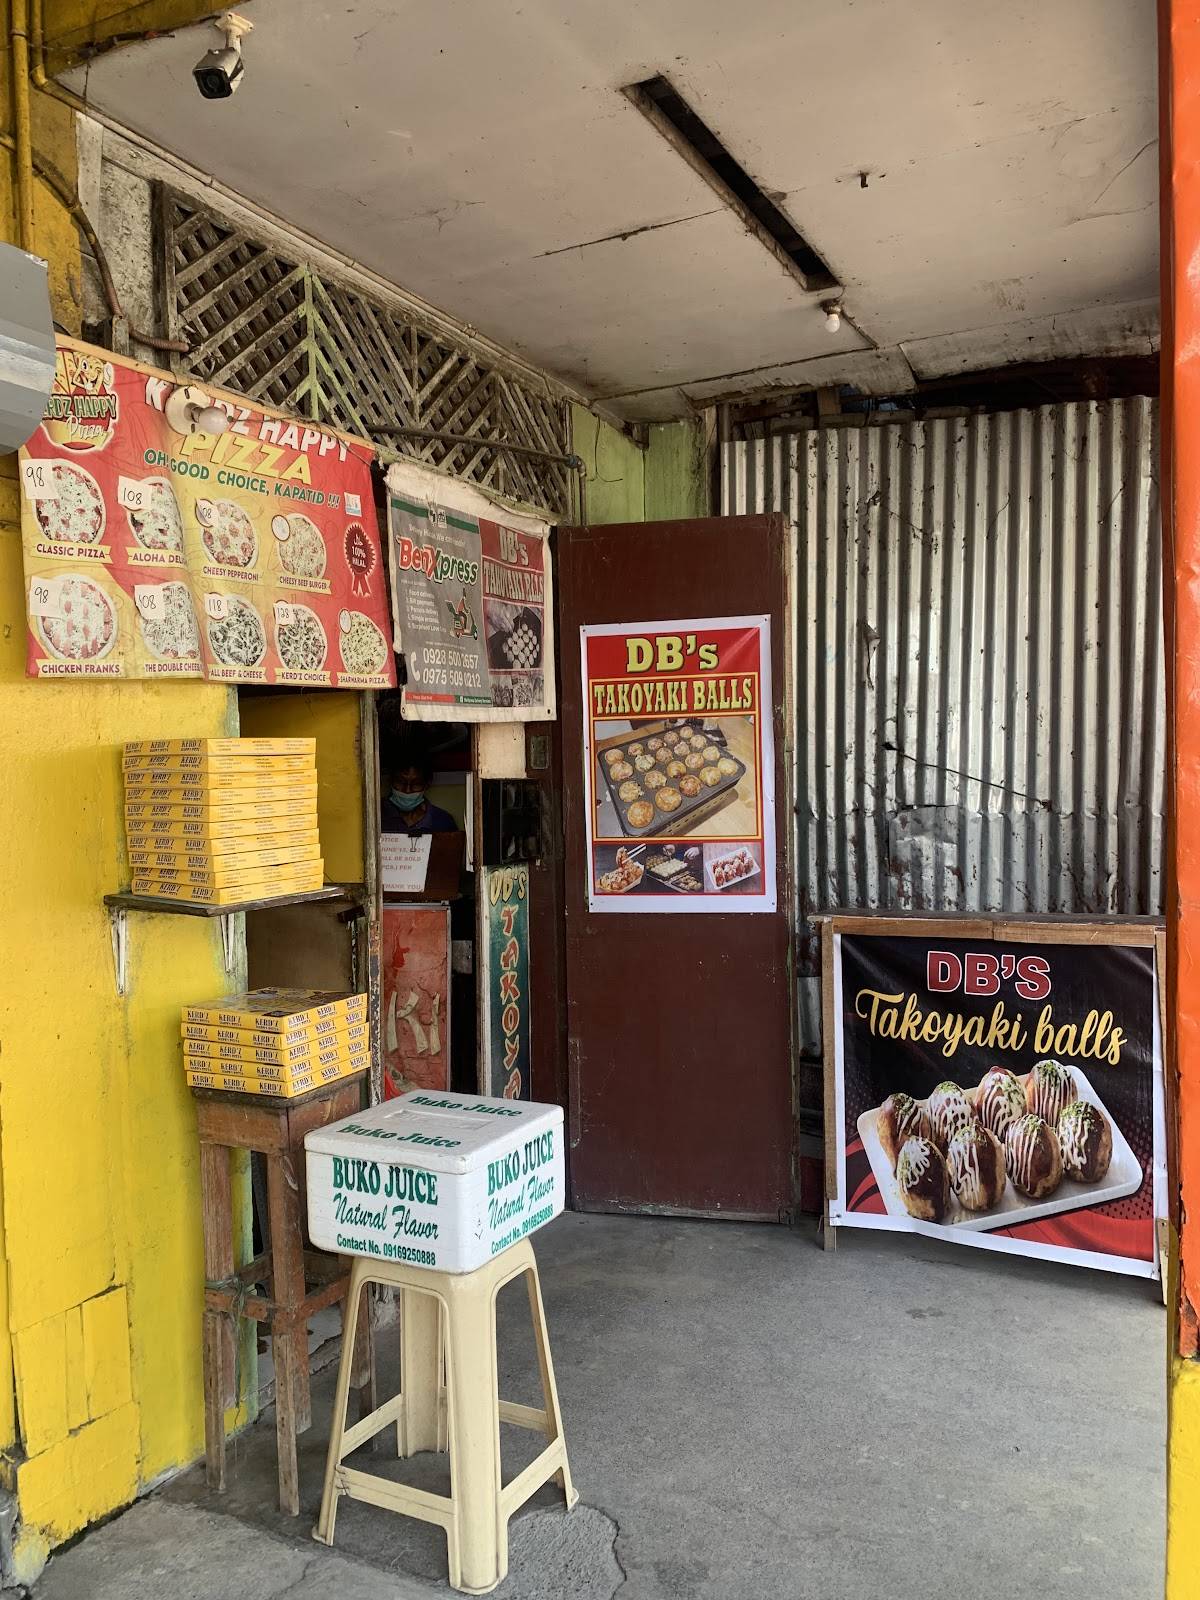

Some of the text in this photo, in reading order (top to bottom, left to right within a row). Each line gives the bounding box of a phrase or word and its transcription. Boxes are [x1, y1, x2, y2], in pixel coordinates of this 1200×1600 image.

[43, 394, 117, 420] RDZ HAPPY
[145, 376, 351, 463] KDZ HAPPY
[179, 431, 312, 486] PIZZA
[26, 466, 45, 488] 98
[144, 447, 170, 469] OH!
[170, 458, 209, 480] GOOD
[217, 470, 270, 496] CHOICE,
[274, 482, 325, 506] KAPATID
[123, 487, 142, 505] 108
[36, 543, 105, 559] CLASSIC PIZZA
[132, 553, 165, 563] ALOHA
[202, 566, 259, 582] CHEESY PEPPERONI
[279, 576, 328, 590] CHEESY BEEF BURGER
[34, 586, 49, 604] 98
[625, 634, 719, 674] DB's
[41, 664, 120, 674] CHICKEN FRANKS
[145, 663, 157, 673] THE
[157, 663, 183, 672] DOUBLE
[211, 669, 221, 678] ALL
[221, 669, 236, 678] BEEF
[243, 671, 263, 679] CHEESE
[304, 673, 326, 682] CHOICE
[422, 668, 447, 685] 0975
[594, 678, 753, 714] TAKOYAKI BALLS
[926, 950, 1052, 1000] DB'S
[855, 988, 1129, 1066] Takoyaki balls
[408, 1096, 523, 1118] Buko Juice
[336, 1123, 462, 1149] Buko Juice
[487, 1130, 554, 1197] BUKO JUICE
[332, 1157, 438, 1207] BUKO JUICE
[488, 1175, 555, 1231] Natural Flavor
[332, 1193, 440, 1241] Natural Flavor
[336, 1233, 436, 1267] Contact No. 09169250888
[491, 1232, 512, 1255] Contact
[512, 1225, 522, 1240] No.
